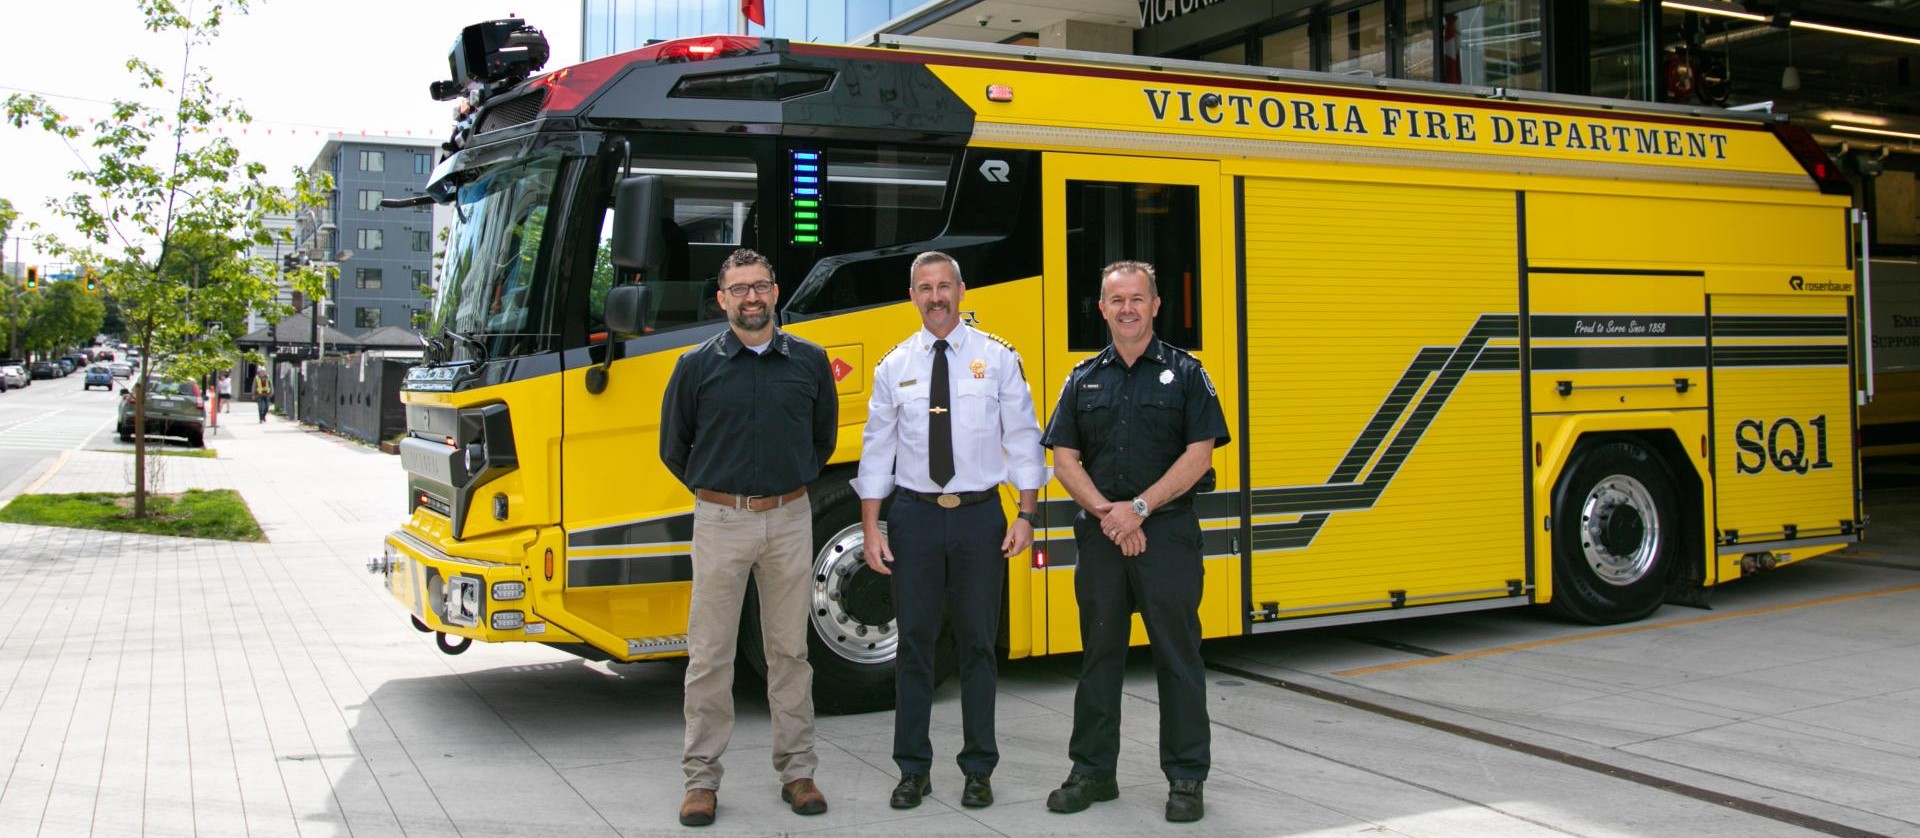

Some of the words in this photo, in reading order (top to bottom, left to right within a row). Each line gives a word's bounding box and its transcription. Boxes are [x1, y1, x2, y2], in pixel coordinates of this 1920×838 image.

[1143, 88, 1369, 134] VICTORIA
[1380, 107, 1477, 142] FIRE
[1490, 116, 1728, 160] DEPARTMENT
[1574, 320, 1596, 334] Proud
[1597, 323, 1604, 333] to
[1606, 320, 1626, 333] Serve
[1628, 320, 1646, 333] Since
[1648, 322, 1666, 333] 1858
[1735, 414, 1833, 475] SQ1
